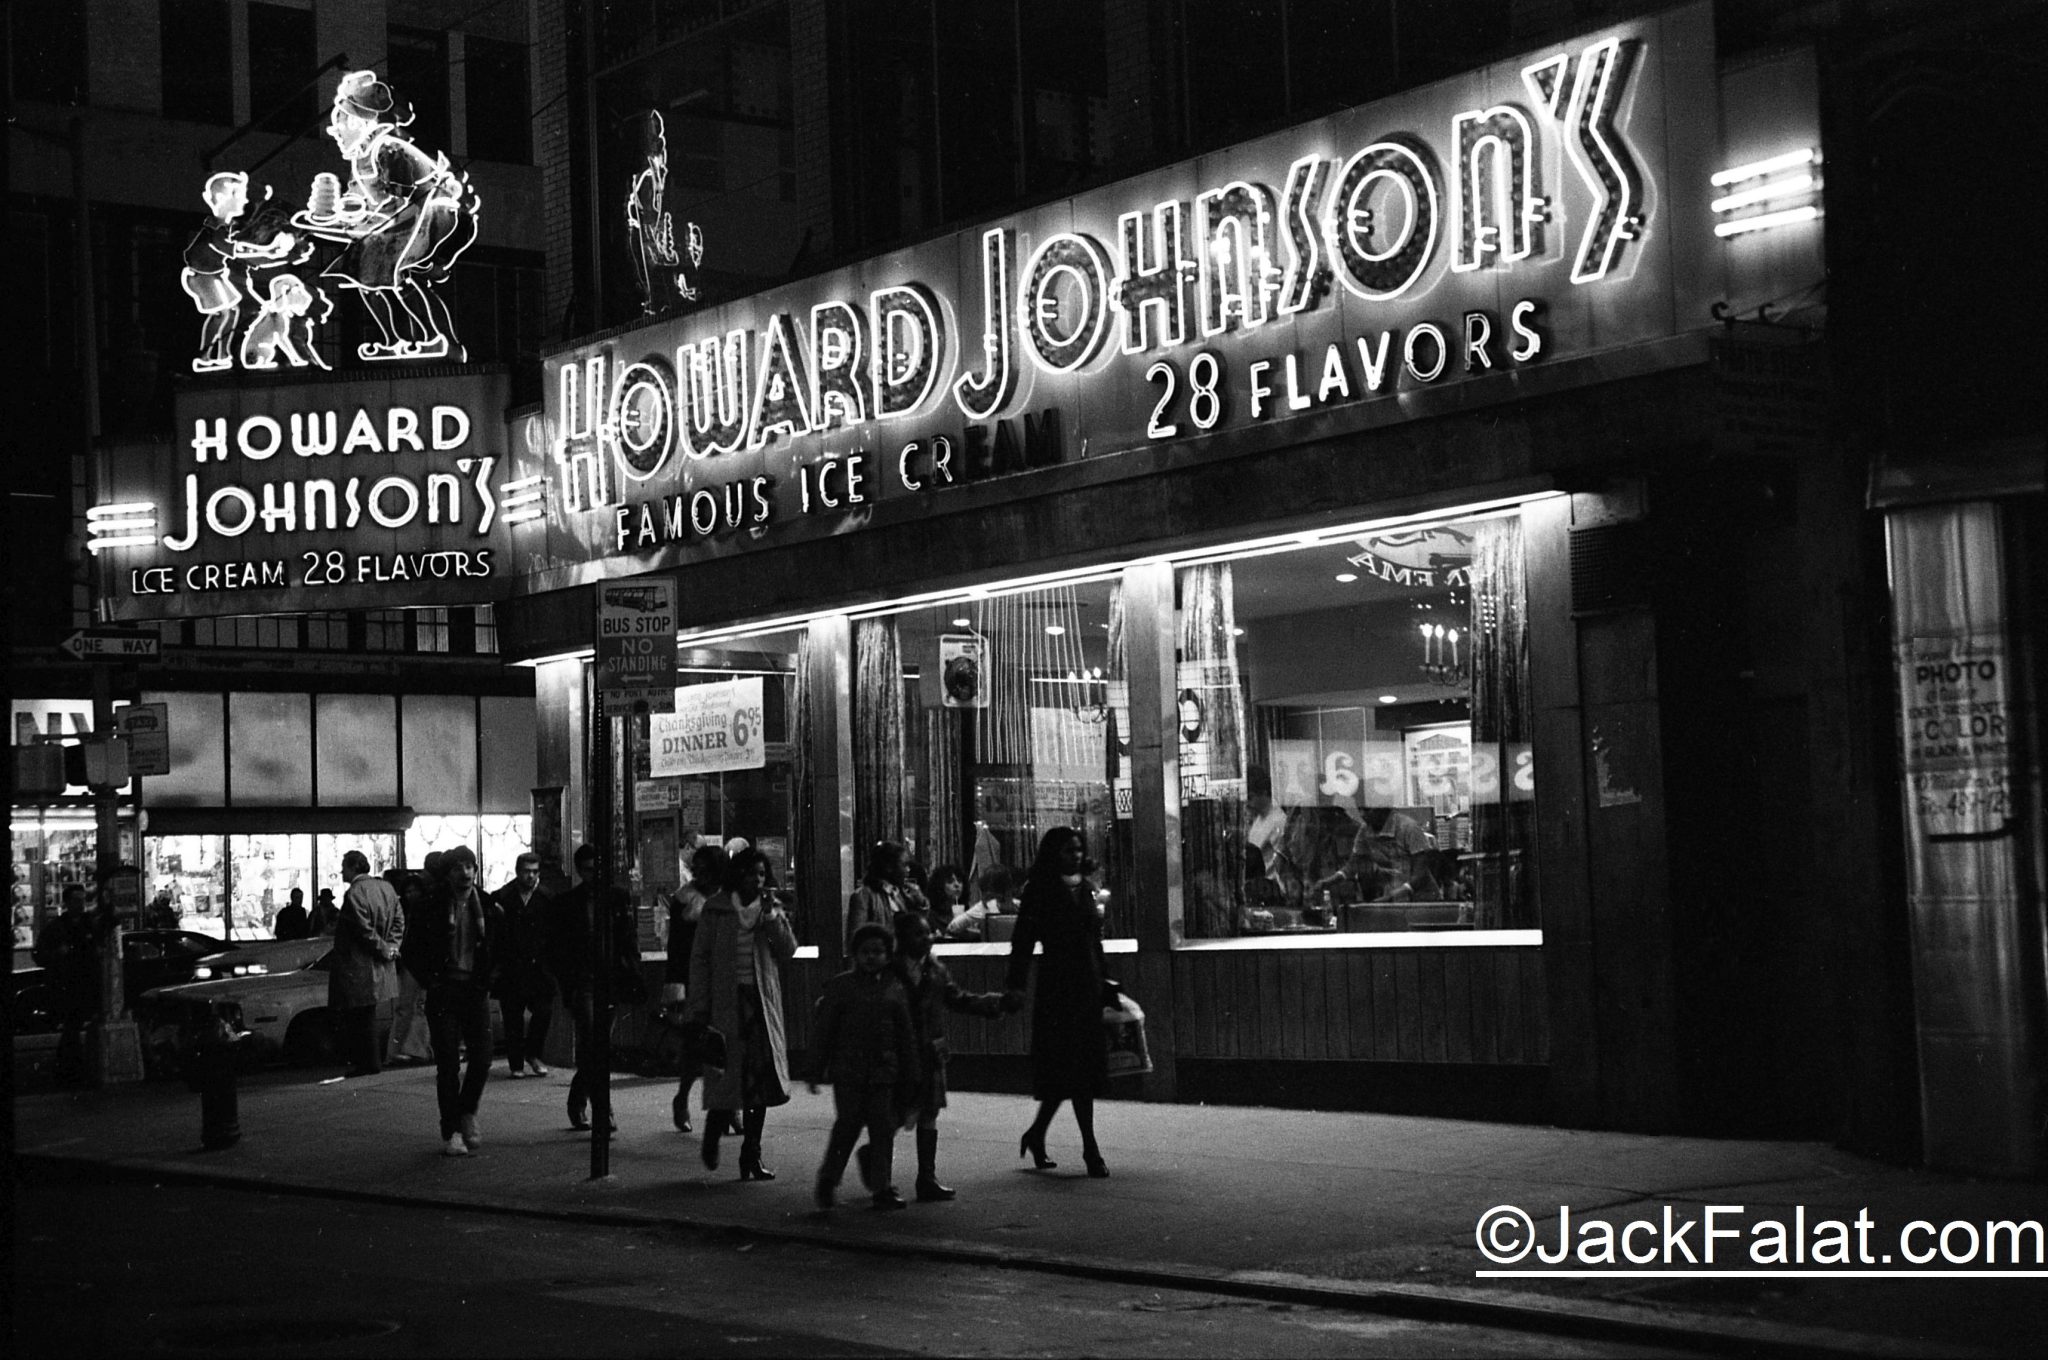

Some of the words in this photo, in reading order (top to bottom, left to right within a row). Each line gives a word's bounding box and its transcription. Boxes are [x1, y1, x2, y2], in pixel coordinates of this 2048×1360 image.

[1146, 353, 1219, 440] 28
[1251, 301, 1542, 419] FLAVORS
[555, 286, 945, 514] HOWARD
[192, 406, 470, 462] HOWARD
[617, 477, 768, 551] FAMOUS
[801, 454, 864, 512] ICE
[899, 408, 1066, 491] CREAM
[132, 566, 174, 594] ICE
[187, 560, 285, 591] CREAM
[303, 551, 346, 586] 28
[358, 551, 490, 583] FLAVORS
[603, 617, 630, 635] BUS
[635, 616, 671, 633] STOP
[73, 633, 104, 651] ONE
[122, 633, 153, 652] WAY
[621, 638, 654, 655] NO
[608, 655, 668, 673] STANDING
[1916, 660, 1996, 685] PHOTO
[658, 712, 728, 733] Thanksgiving
[1925, 716, 2005, 741] COLOR
[661, 731, 729, 755] DINNER
